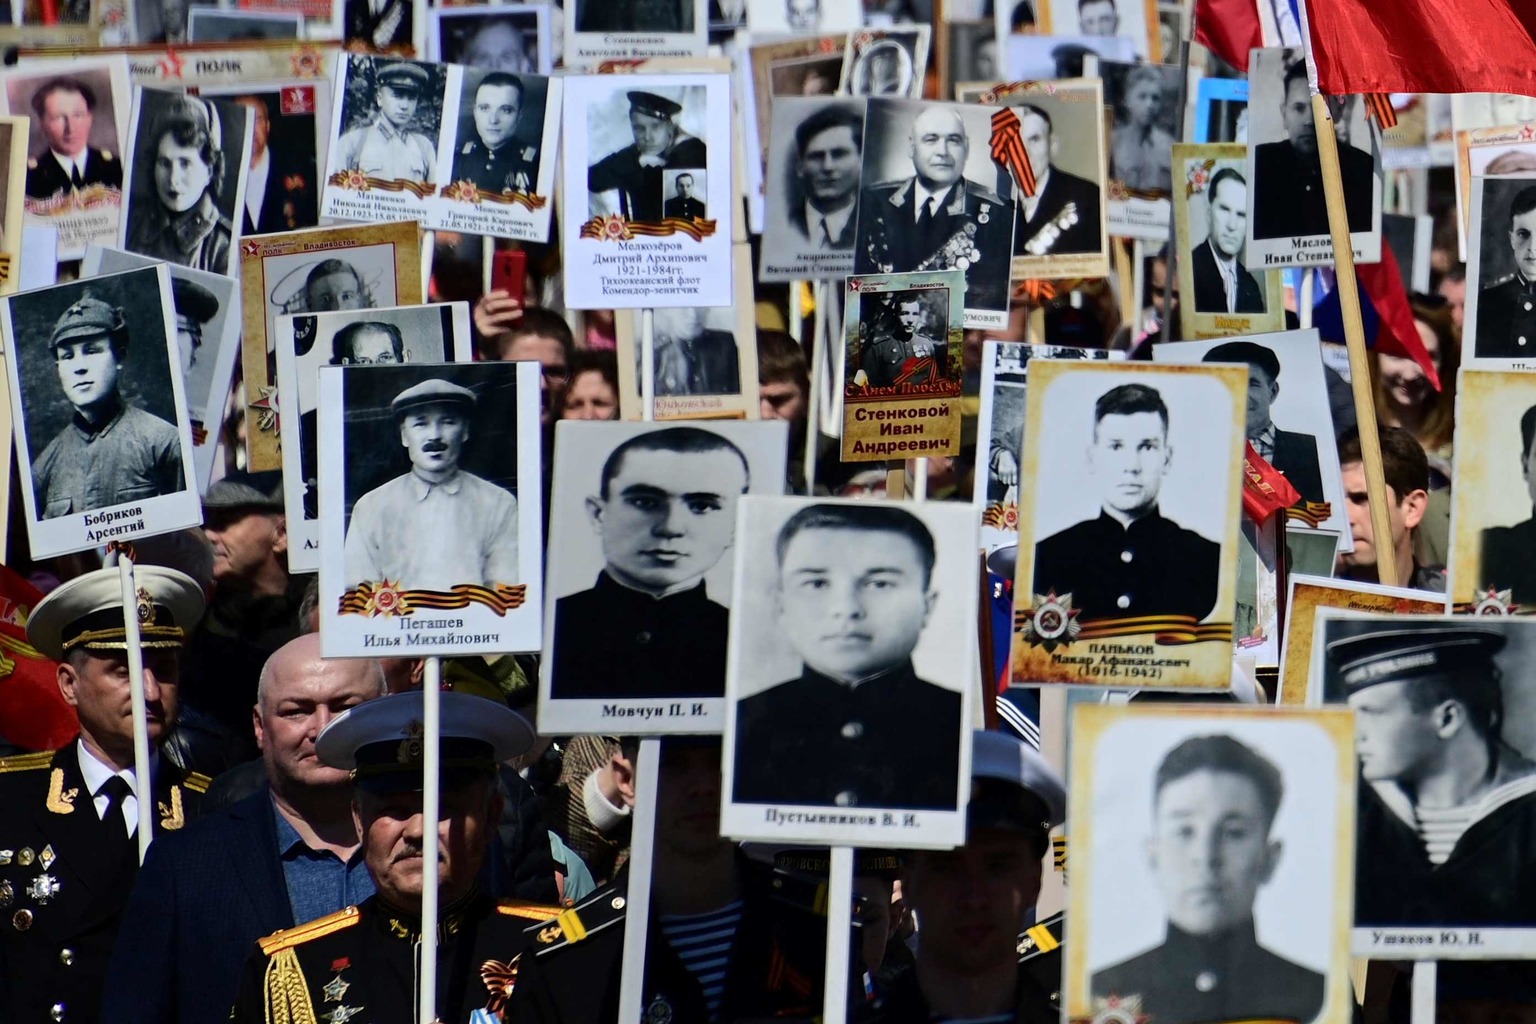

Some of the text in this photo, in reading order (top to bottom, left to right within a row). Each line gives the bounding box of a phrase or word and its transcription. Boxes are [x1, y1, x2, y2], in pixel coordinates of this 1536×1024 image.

[333, 198, 371, 210] Николай
[303, 239, 357, 251] Владивосток
[593, 254, 708, 267] Дмитрий Архипович
[1265, 253, 1293, 265] Иван
[601, 275, 701, 286] Тихоокеанский флот
[602, 286, 699, 297] Комендор-зенитчик
[845, 384, 854, 397] С
[855, 403, 949, 421] Стенковой
[880, 421, 923, 437] Иван
[852, 438, 950, 455] Андреевич
[84, 506, 144, 527] Бобриков
[86, 519, 146, 542] Арсентий
[400, 617, 464, 631] Пегашев
[364, 632, 501, 647] Илья Михайлович
[1089, 643, 1155, 655] ПАНЬКОВ
[1051, 654, 1191, 668] Макар Афанасьевич
[1078, 666, 1163, 679] (1916-1942)
[601, 702, 708, 720] Мовчун П. И.
[765, 807, 921, 827] Пустынников В. И.
[1373, 931, 1435, 945] Ушаков
[1440, 931, 1462, 945] Ю.
